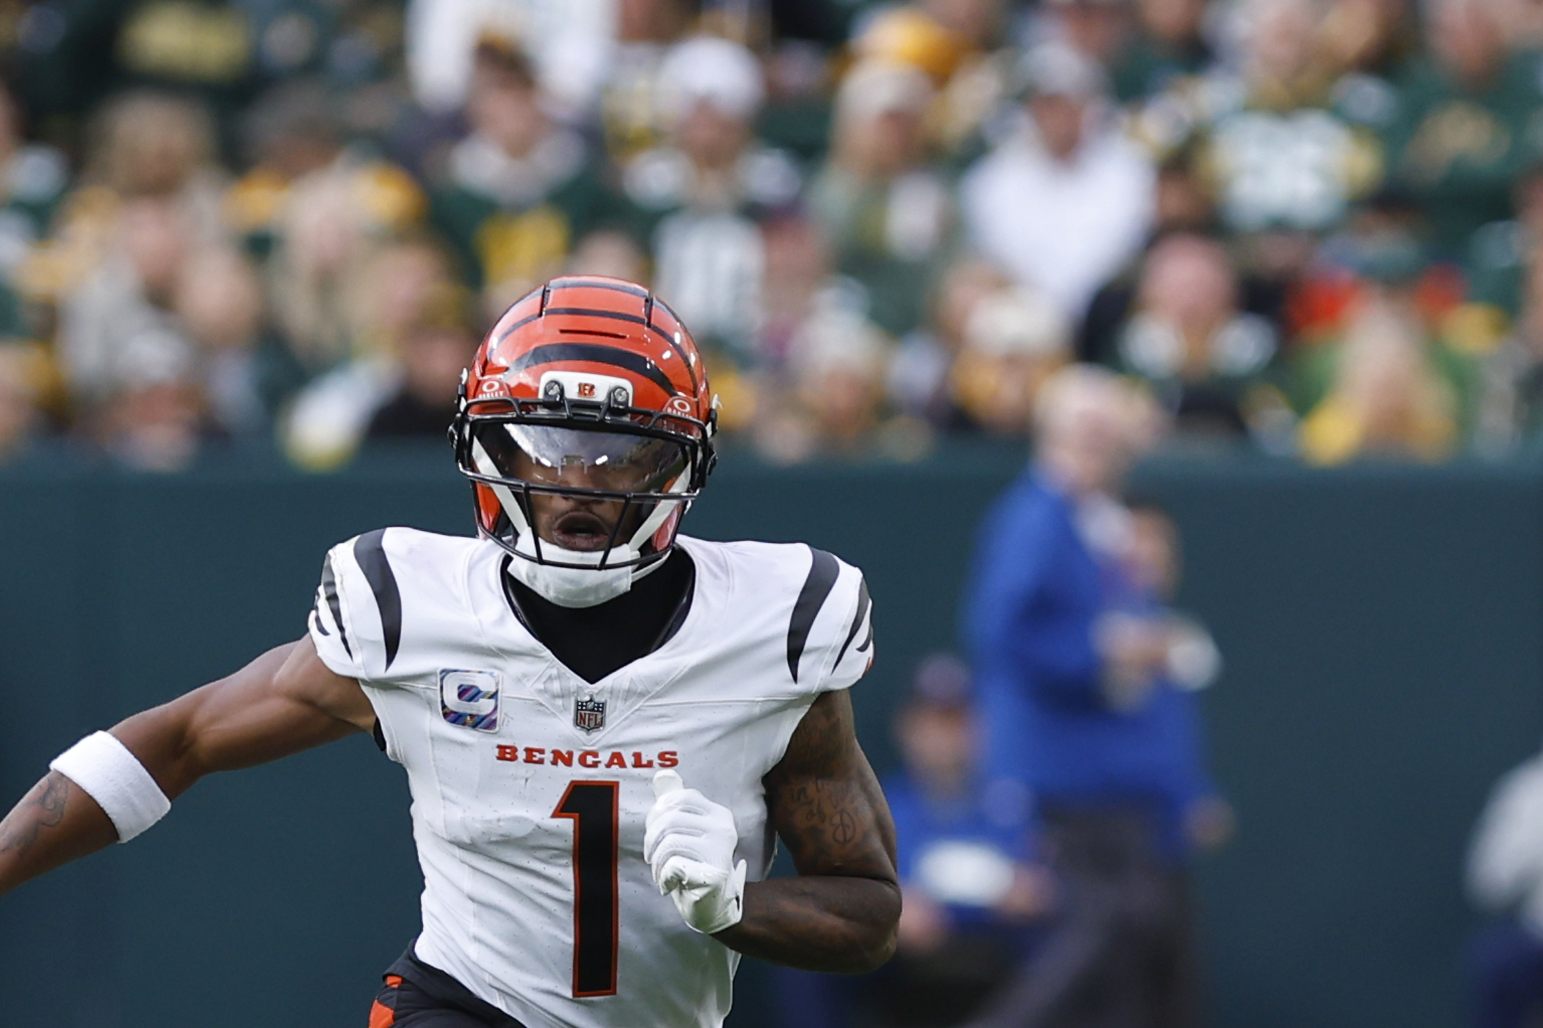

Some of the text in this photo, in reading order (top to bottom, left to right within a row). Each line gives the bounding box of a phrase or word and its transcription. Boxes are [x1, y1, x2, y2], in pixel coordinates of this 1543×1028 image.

[578, 711, 604, 729] NFL
[495, 744, 680, 769] BENGALS
[550, 780, 620, 998] 1
